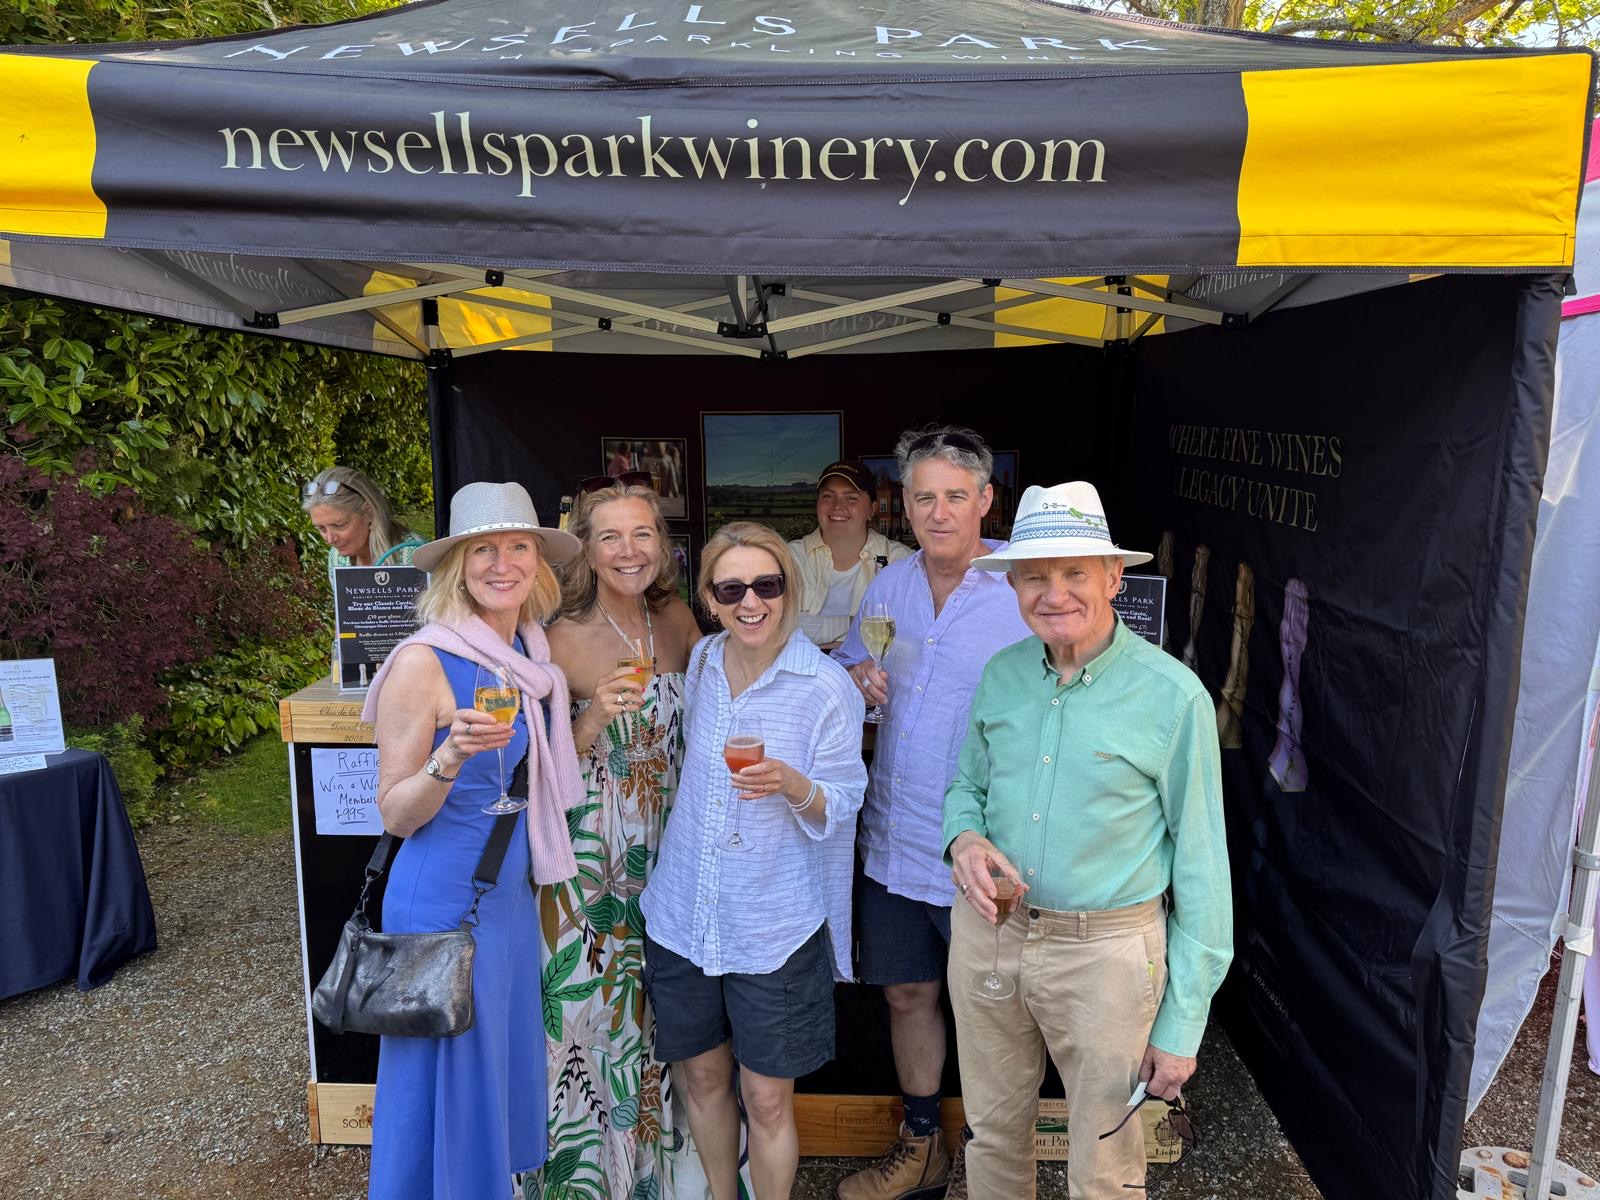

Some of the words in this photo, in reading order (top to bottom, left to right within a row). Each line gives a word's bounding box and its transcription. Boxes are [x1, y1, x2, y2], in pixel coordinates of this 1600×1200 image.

[223, 3, 797, 61] NEWSELLS
[874, 25, 1167, 52] PARK
[220, 110, 1107, 206] newsellsparkwinery.com
[1169, 424, 1217, 459] WHERE
[1221, 427, 1263, 466] FINE
[1267, 432, 1342, 479] WINES
[1180, 466, 1245, 511] LEGACY
[1248, 480, 1319, 532] UNITE
[345, 586, 392, 595] NEWSELLS
[396, 586, 420, 594] PARK
[1132, 596, 1154, 605] PARK
[336, 751, 381, 771] Raffle
[319, 775, 344, 792] Win
